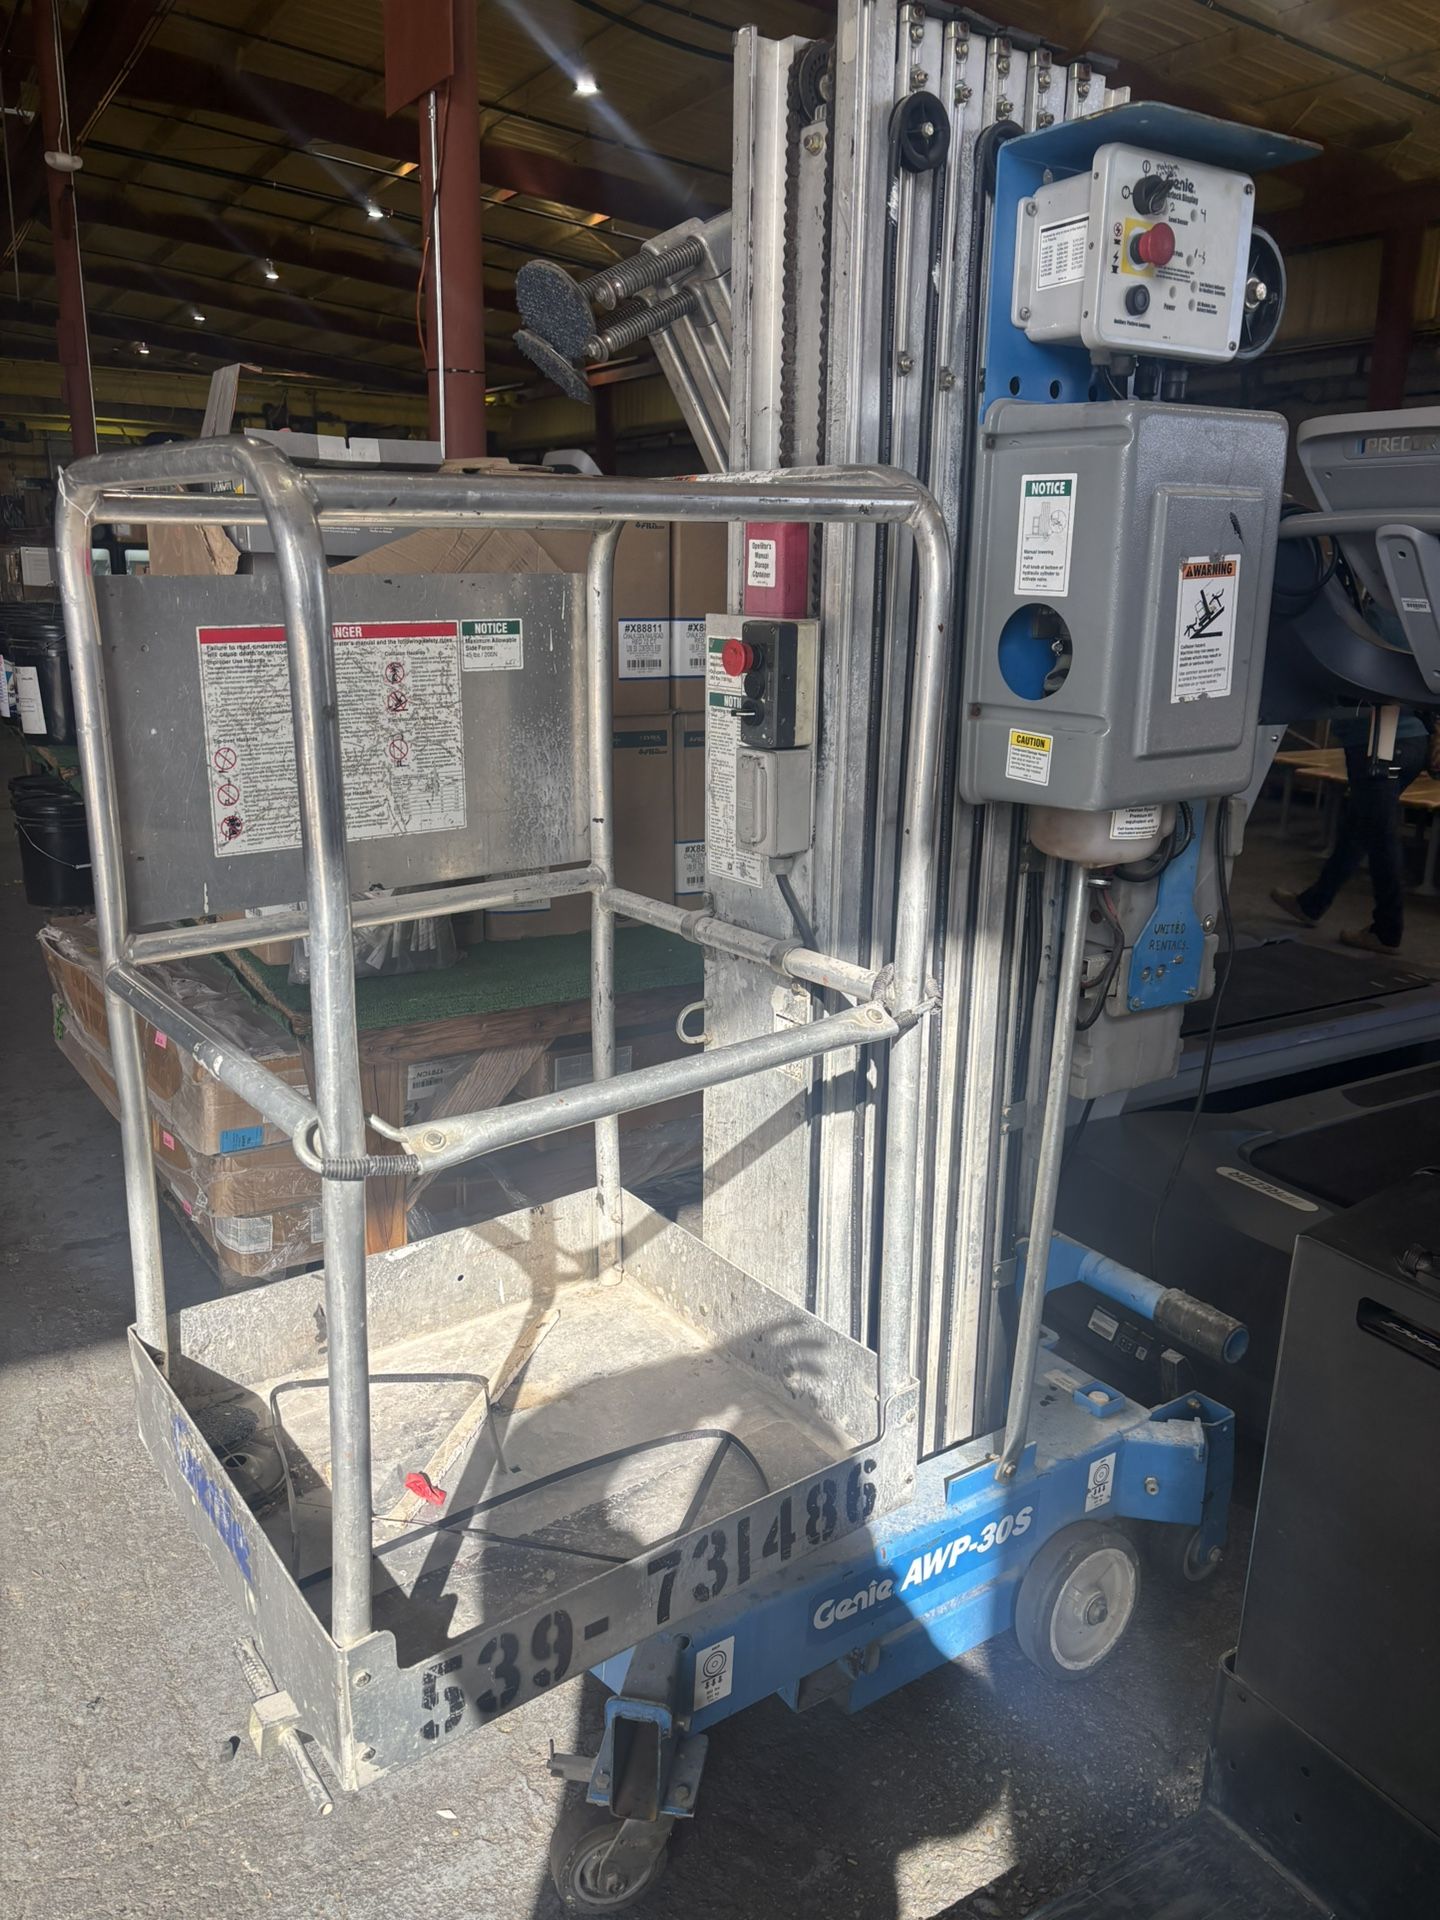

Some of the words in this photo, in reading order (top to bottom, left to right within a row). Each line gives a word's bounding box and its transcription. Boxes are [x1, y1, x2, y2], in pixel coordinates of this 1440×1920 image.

[1031, 481, 1065, 495] NOTICE
[1193, 562, 1232, 577] WARNING
[333, 626, 362, 638] NGER
[475, 622, 508, 634] NOTICE
[625, 624, 662, 633] #X88811
[1016, 734, 1045, 748] CAUTION
[1154, 923, 1185, 934] UNITED
[901, 1505, 1033, 1592] AWP-30S
[813, 1579, 894, 1630] Genie
